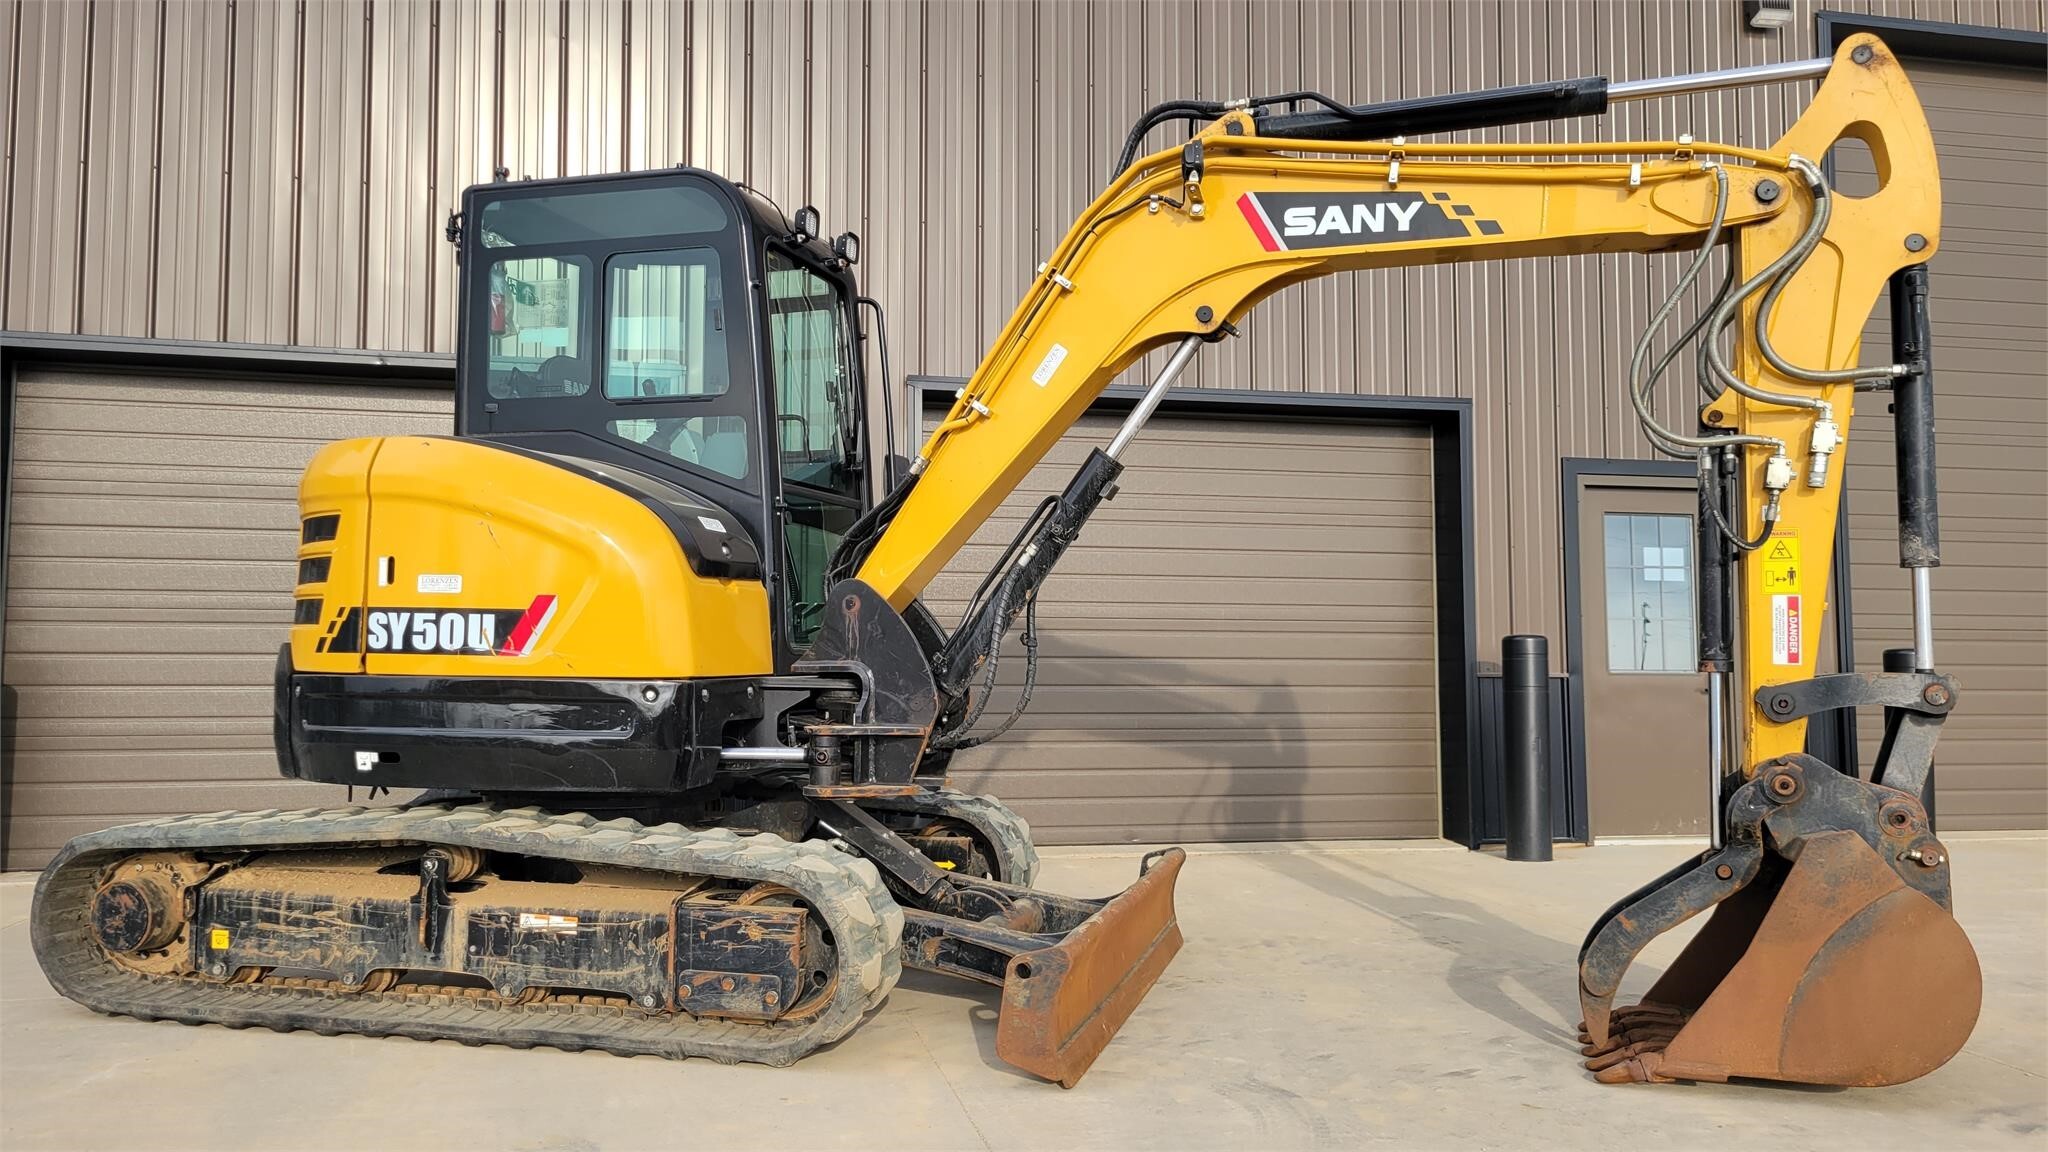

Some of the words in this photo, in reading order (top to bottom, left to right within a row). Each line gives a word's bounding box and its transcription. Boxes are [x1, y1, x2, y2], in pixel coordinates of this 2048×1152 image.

[1284, 201, 1424, 236] SANY
[367, 612, 495, 650] SY50U
[1788, 616, 1799, 654] DANGER
